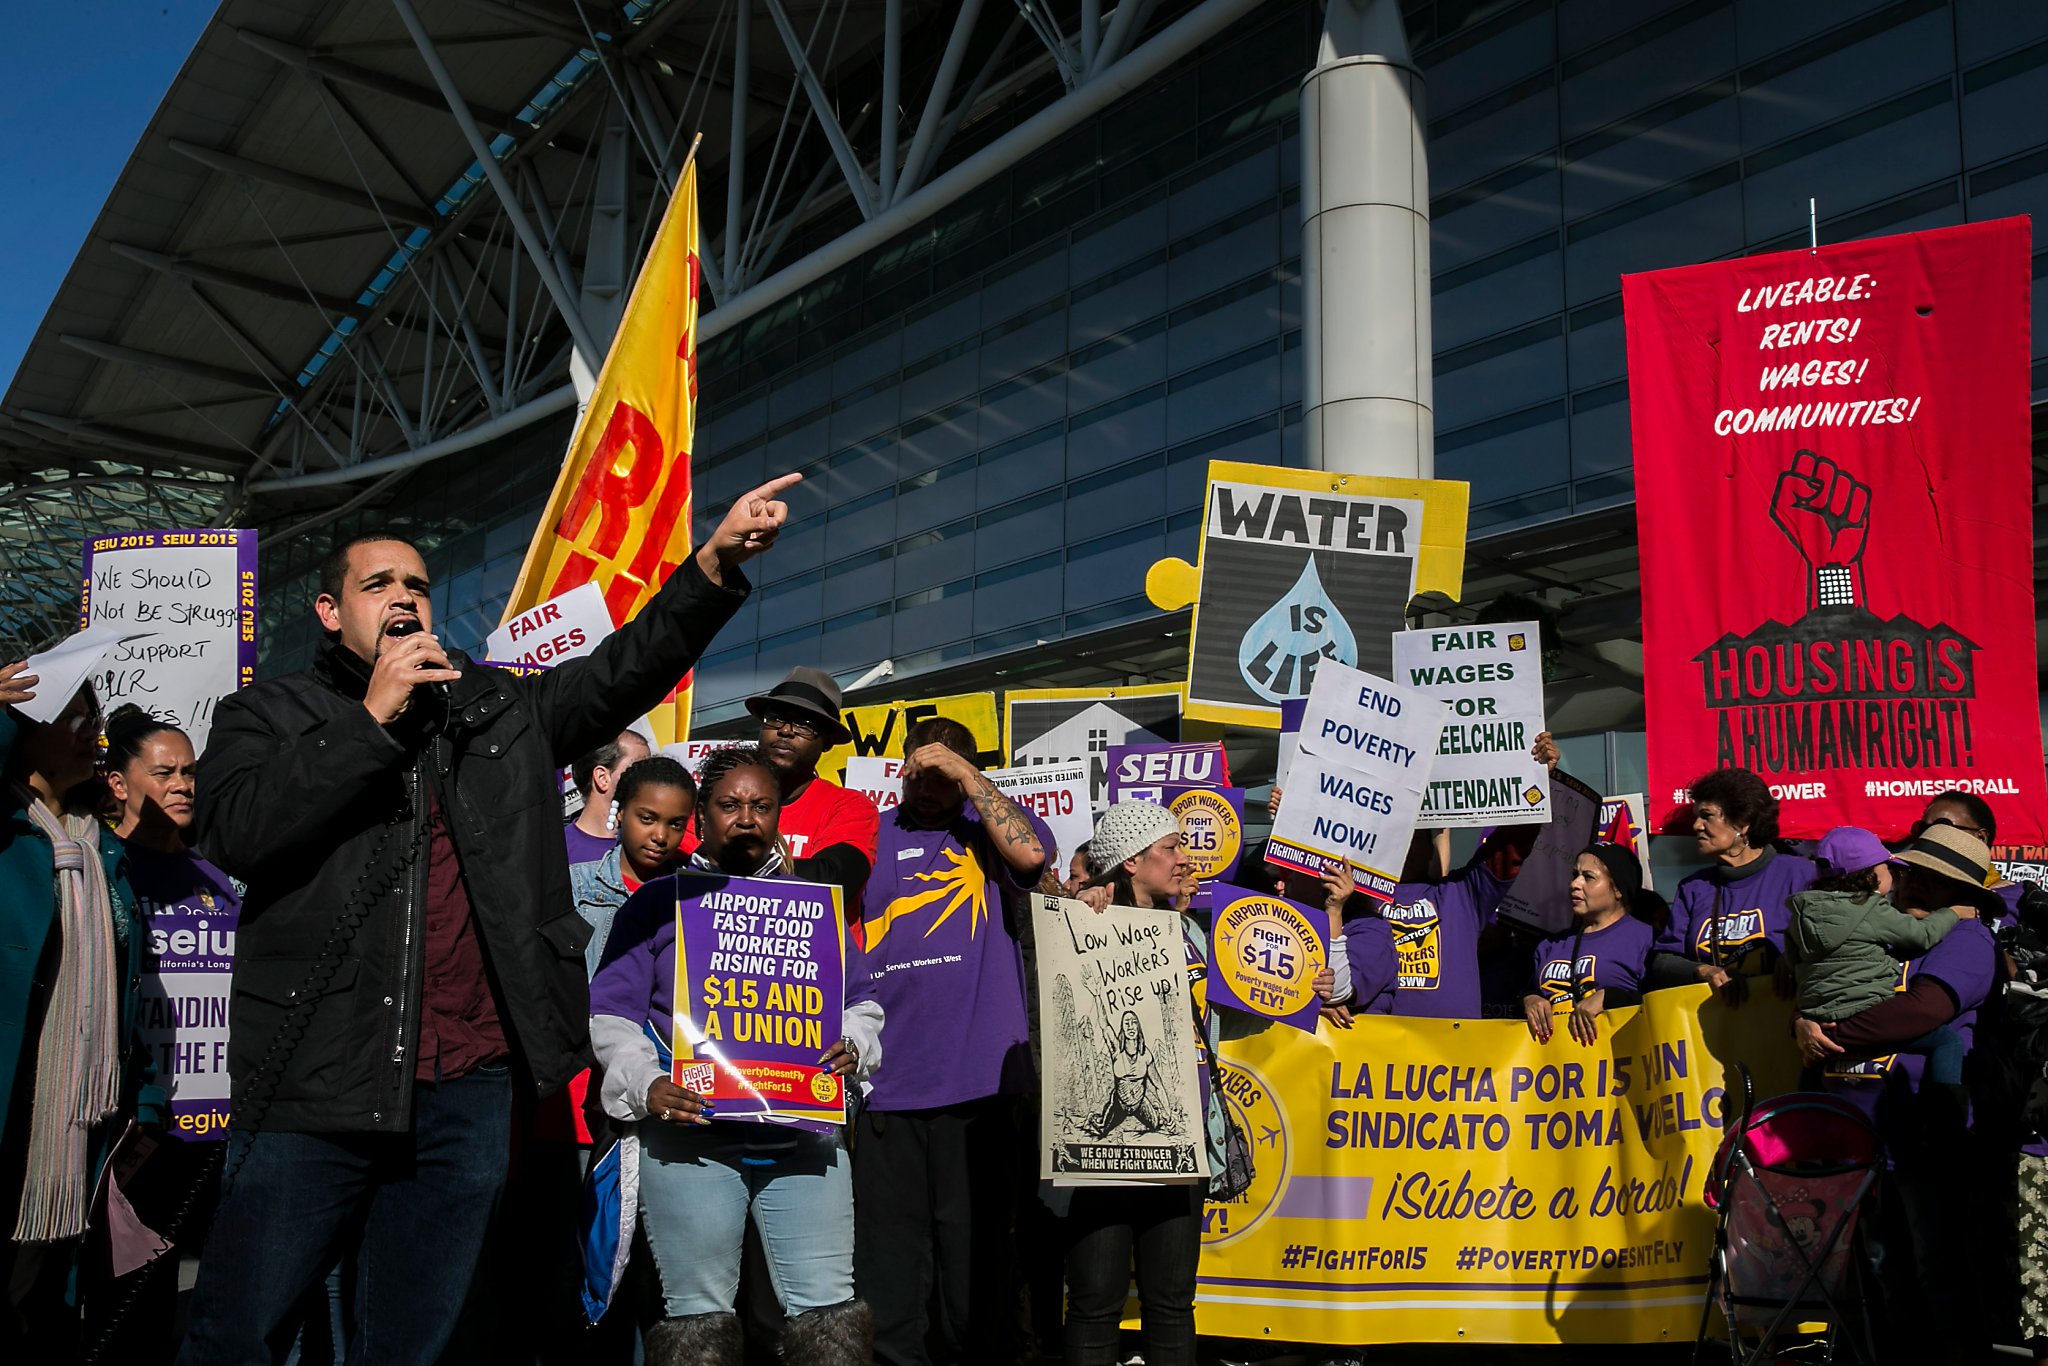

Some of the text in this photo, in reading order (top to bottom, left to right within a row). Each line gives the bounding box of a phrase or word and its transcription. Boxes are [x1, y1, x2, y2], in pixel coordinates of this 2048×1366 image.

[1737, 273, 1878, 313] LIVEABLE:
[1759, 318, 1861, 350] RENTS!
[1759, 358, 1869, 392] WAGES!
[1714, 397, 1921, 437] COMMUNITIES!
[1217, 487, 1408, 553] WATER
[93, 535, 154, 551] SEIU 2015
[162, 533, 237, 545] SEIU 2015
[94, 565, 122, 591] WE
[242, 571, 254, 607] 2015
[135, 601, 163, 623] BE
[509, 603, 562, 642] FAIR
[1290, 604, 1328, 634] IS
[1432, 630, 1497, 652] FAIR
[1410, 663, 1515, 687] WAGES
[1712, 639, 1967, 700] HOUSING IS
[1358, 686, 1401, 718] END
[1321, 719, 1416, 768] POVERTY
[1436, 721, 1526, 756] EELCHAIR
[1717, 707, 1737, 769] A
[1020, 775, 1053, 786] SERVICE
[1055, 771, 1084, 781] UNITED
[1119, 752, 1213, 784] SEIU
[1320, 773, 1393, 815] WAGES
[1420, 776, 1522, 811] ATTENDANT
[1865, 778, 2020, 798] #HOMESFORALL
[1186, 817, 1212, 826] FIGHT
[1199, 795, 1234, 826] WORKERS
[1180, 831, 1217, 851] $15
[1312, 817, 1378, 854] NOW!
[1269, 842, 1304, 865] FIGHTING
[1306, 853, 1321, 869] FOR
[1372, 877, 1396, 894] RIGHTS
[700, 892, 824, 920] AIRPORT AND
[147, 920, 235, 957] seiu
[713, 912, 814, 938] FAST FOOD
[1226, 903, 1319, 953] AIRPORT WORKERS
[1253, 927, 1291, 947] FIGHT
[1394, 926, 1432, 945] JUSTICE
[718, 932, 811, 959] WORKERS
[1266, 943, 1279, 951] FOR
[1398, 945, 1435, 964] RKERS
[150, 960, 231, 970] lifornia's Long
[709, 952, 819, 981] RISING FOR
[885, 954, 962, 973] Service Workers West
[1243, 944, 1295, 980] $15
[703, 974, 824, 1016] $15 AND
[1235, 971, 1300, 999] Poverty wages don't
[1398, 976, 1426, 987] SWW
[141, 997, 226, 1029] TANDIN
[1250, 987, 1285, 1010] FLY!
[703, 1010, 822, 1050] A UNION
[160, 1042, 205, 1074] THE
[683, 1063, 709, 1081] FIGHT
[1331, 1061, 1374, 1100] LA
[1384, 1064, 1498, 1103] LUCHA
[1510, 1062, 1585, 1103] POR
[1325, 1110, 1510, 1151] SINDICATO
[1525, 1108, 1625, 1151] TOMA
[1080, 1147, 1172, 1160] WE GROW STRONGER
[1081, 1158, 1173, 1171] WHEN WE FIGHT BACK!
[1382, 1154, 1694, 1221] ¡Súbete a bordo!
